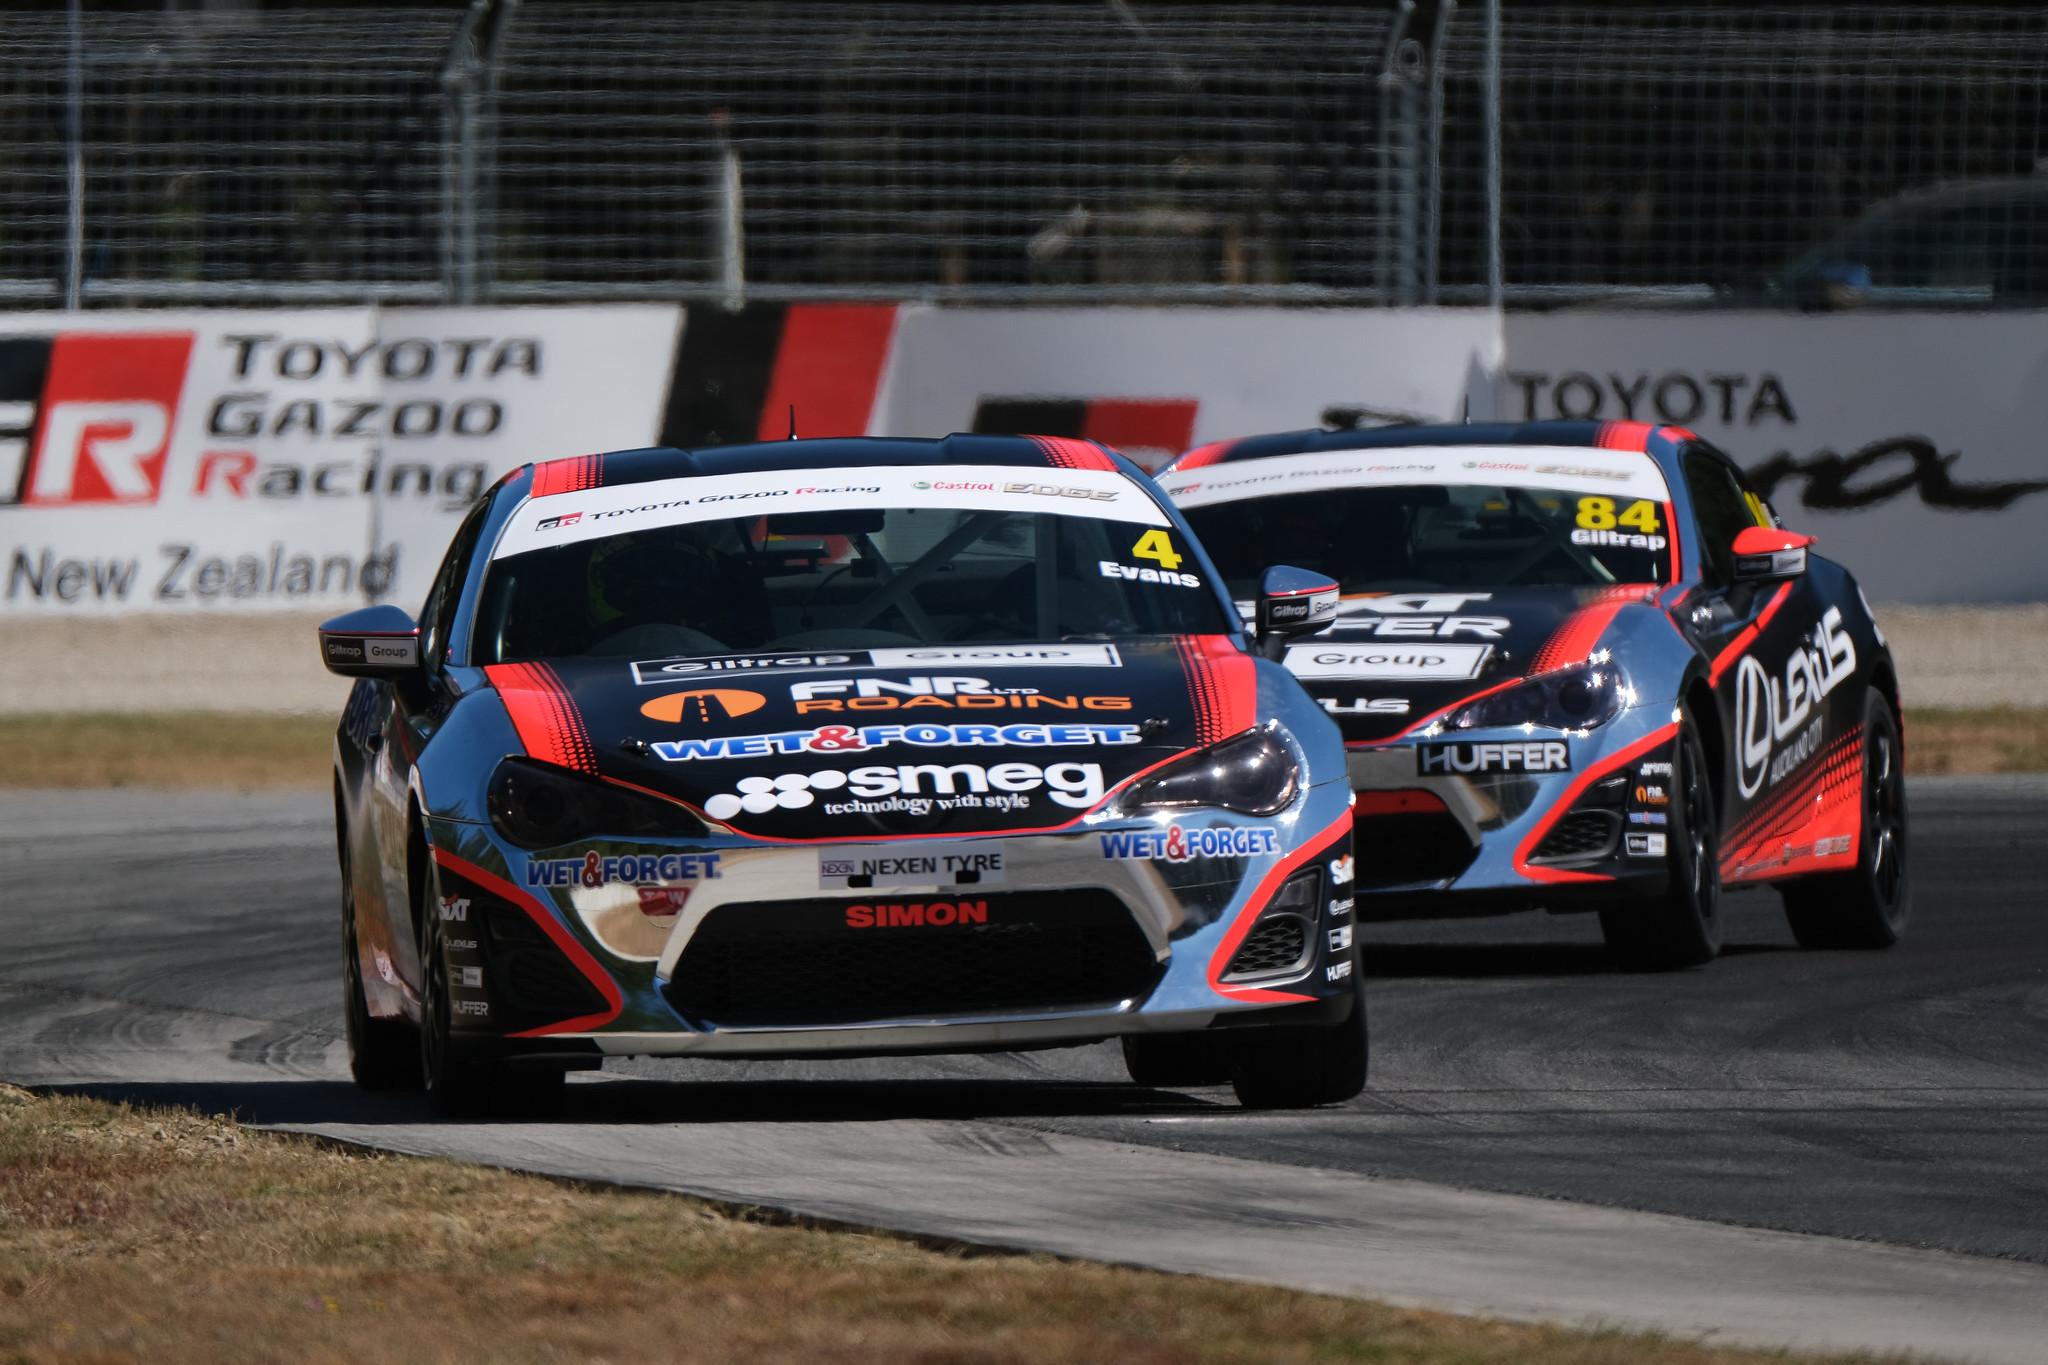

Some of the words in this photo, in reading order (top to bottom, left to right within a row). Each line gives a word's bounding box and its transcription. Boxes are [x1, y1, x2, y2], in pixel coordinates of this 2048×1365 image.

[215, 333, 543, 381] TOYOTA
[1507, 371, 1796, 425] TOYOTA
[205, 392, 505, 440] GAZOO
[195, 450, 487, 512] Racing
[933, 480, 994, 492] Castrol
[1002, 480, 1119, 502] EDGE
[589, 500, 691, 520] TOYOTA
[699, 490, 790, 504] GAZOO
[795, 486, 881, 495] Racing
[1575, 496, 1660, 533] 84
[1132, 529, 1183, 570] 4
[1571, 529, 1666, 550] Giltrap
[7, 543, 138, 602] New
[155, 543, 400, 600] Zealand
[1098, 561, 1200, 588] Evans
[1272, 605, 1308, 617] Giltrap
[371, 646, 408, 657] Group
[661, 655, 851, 672] Giltrap
[906, 651, 1071, 660] Group
[1313, 652, 1446, 668] Group
[790, 676, 991, 701] FNR
[1770, 605, 1856, 742] LEXUS
[795, 694, 1133, 714] ROADING
[649, 722, 1143, 762] WET&FORGET
[1423, 742, 1568, 773] HUFFER
[848, 762, 1104, 809] smeg
[824, 795, 933, 816] technology
[940, 795, 983, 808] with
[985, 793, 1030, 813] style
[1100, 825, 1280, 863] WET&FORGET
[526, 850, 722, 889] WET&FORGET
[861, 857, 937, 876] NEXEN
[943, 853, 1002, 874] TYRE
[846, 901, 988, 928] SIMON
